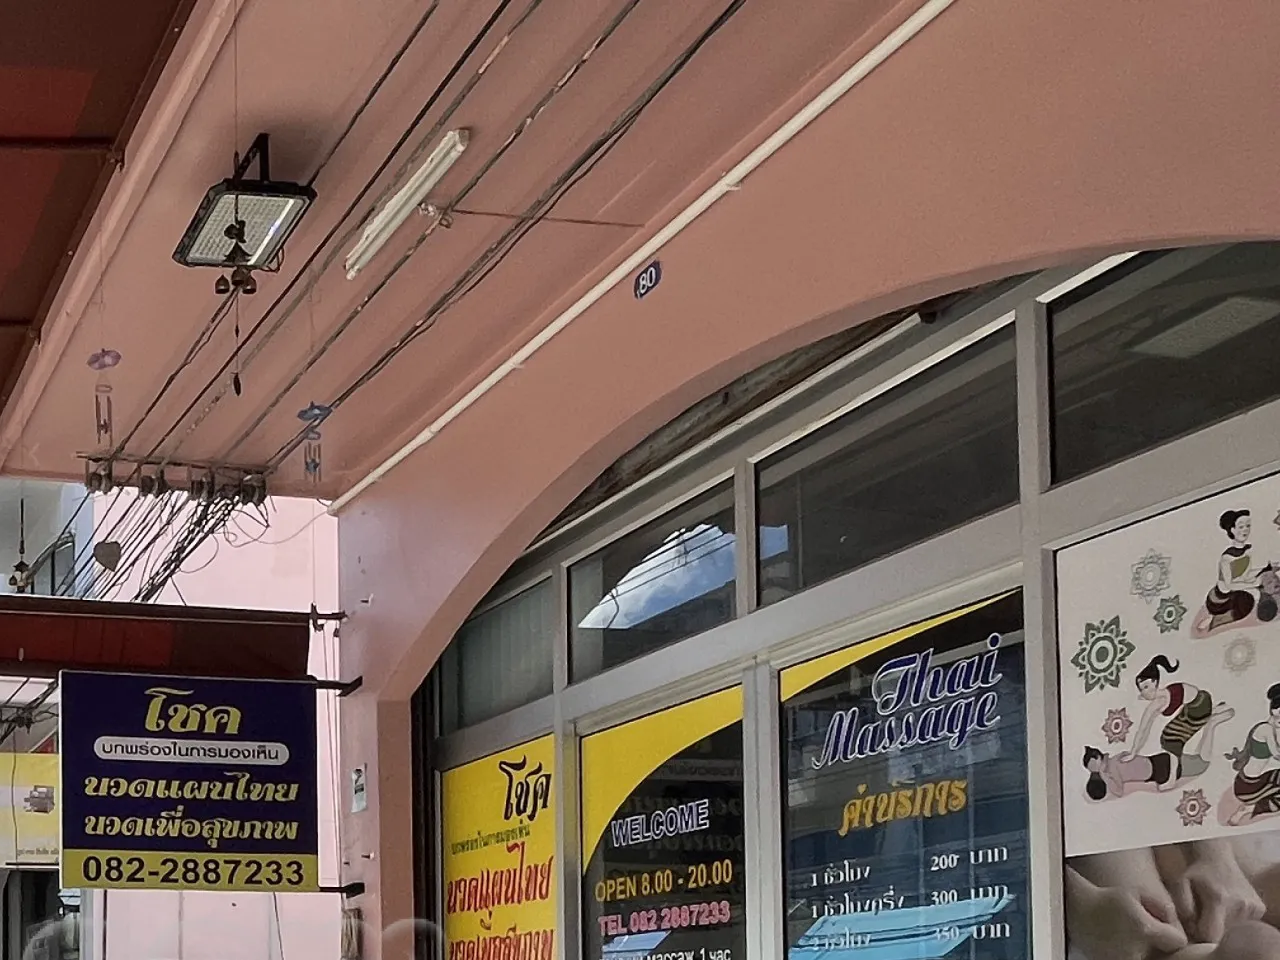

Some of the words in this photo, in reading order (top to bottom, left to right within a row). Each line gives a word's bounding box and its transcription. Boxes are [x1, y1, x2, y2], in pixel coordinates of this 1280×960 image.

[872, 632, 1003, 716] Thai
[144, 687, 242, 734] โชค
[811, 692, 1001, 769] Massage
[102, 741, 279, 760] บกพร่องในการมองเห็น
[84, 771, 299, 802] นวดแผนไทย
[499, 754, 551, 821] โชค
[838, 777, 968, 836] ค่าบริการ
[84, 805, 299, 848] นวดเพื่อสุขภาพ
[610, 799, 710, 848] WELCOME
[83, 856, 304, 886] 082-2887233
[447, 841, 554, 918] นวดแผนไทย
[595, 875, 636, 902] OPEN
[641, 869, 673, 896] 8.00
[688, 859, 733, 889] 20.00
[810, 873, 818, 887] 1
[930, 854, 958, 871] 200
[970, 846, 1008, 864] บาท
[661, 900, 730, 928] 2887233
